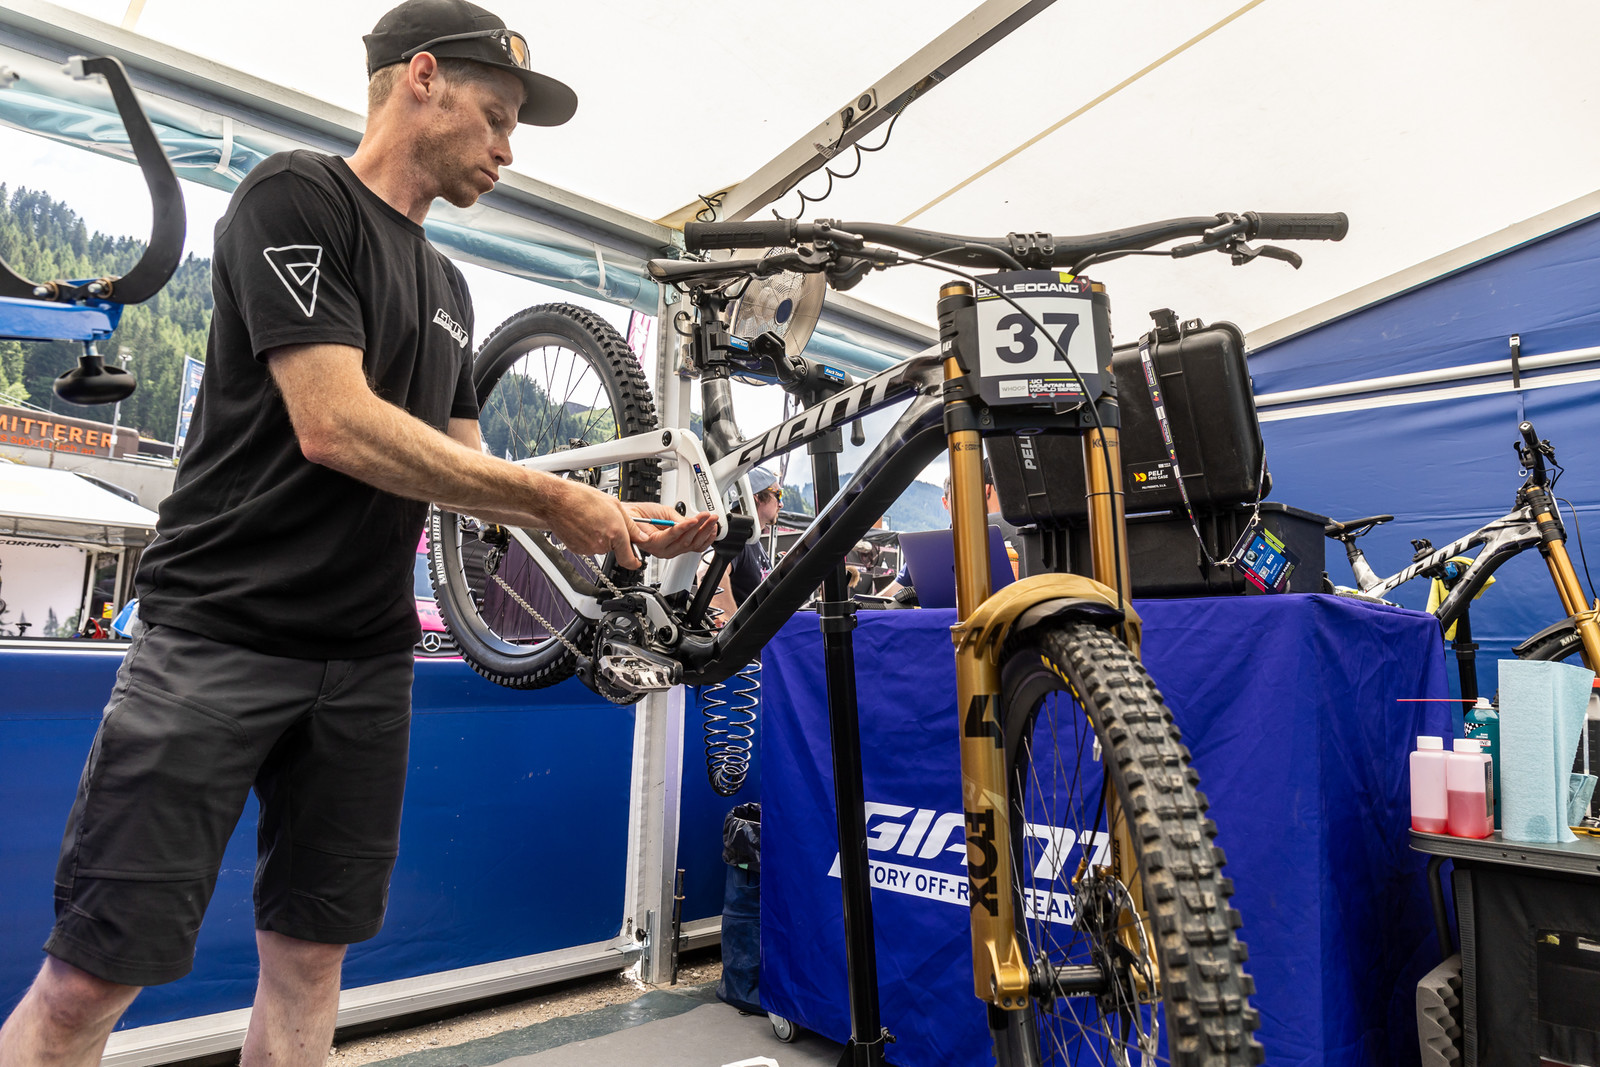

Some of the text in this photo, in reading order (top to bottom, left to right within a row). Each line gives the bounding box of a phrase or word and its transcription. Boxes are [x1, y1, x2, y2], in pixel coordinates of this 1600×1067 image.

[1002, 283, 1079, 294] LEOGANG
[995, 312, 1080, 364] 37
[735, 362, 912, 467] GIANT
[1021, 435, 1037, 470] PELI
[433, 543, 446, 586] MINION
[964, 808, 999, 917] FOX
[915, 874, 969, 900] OFF-R
